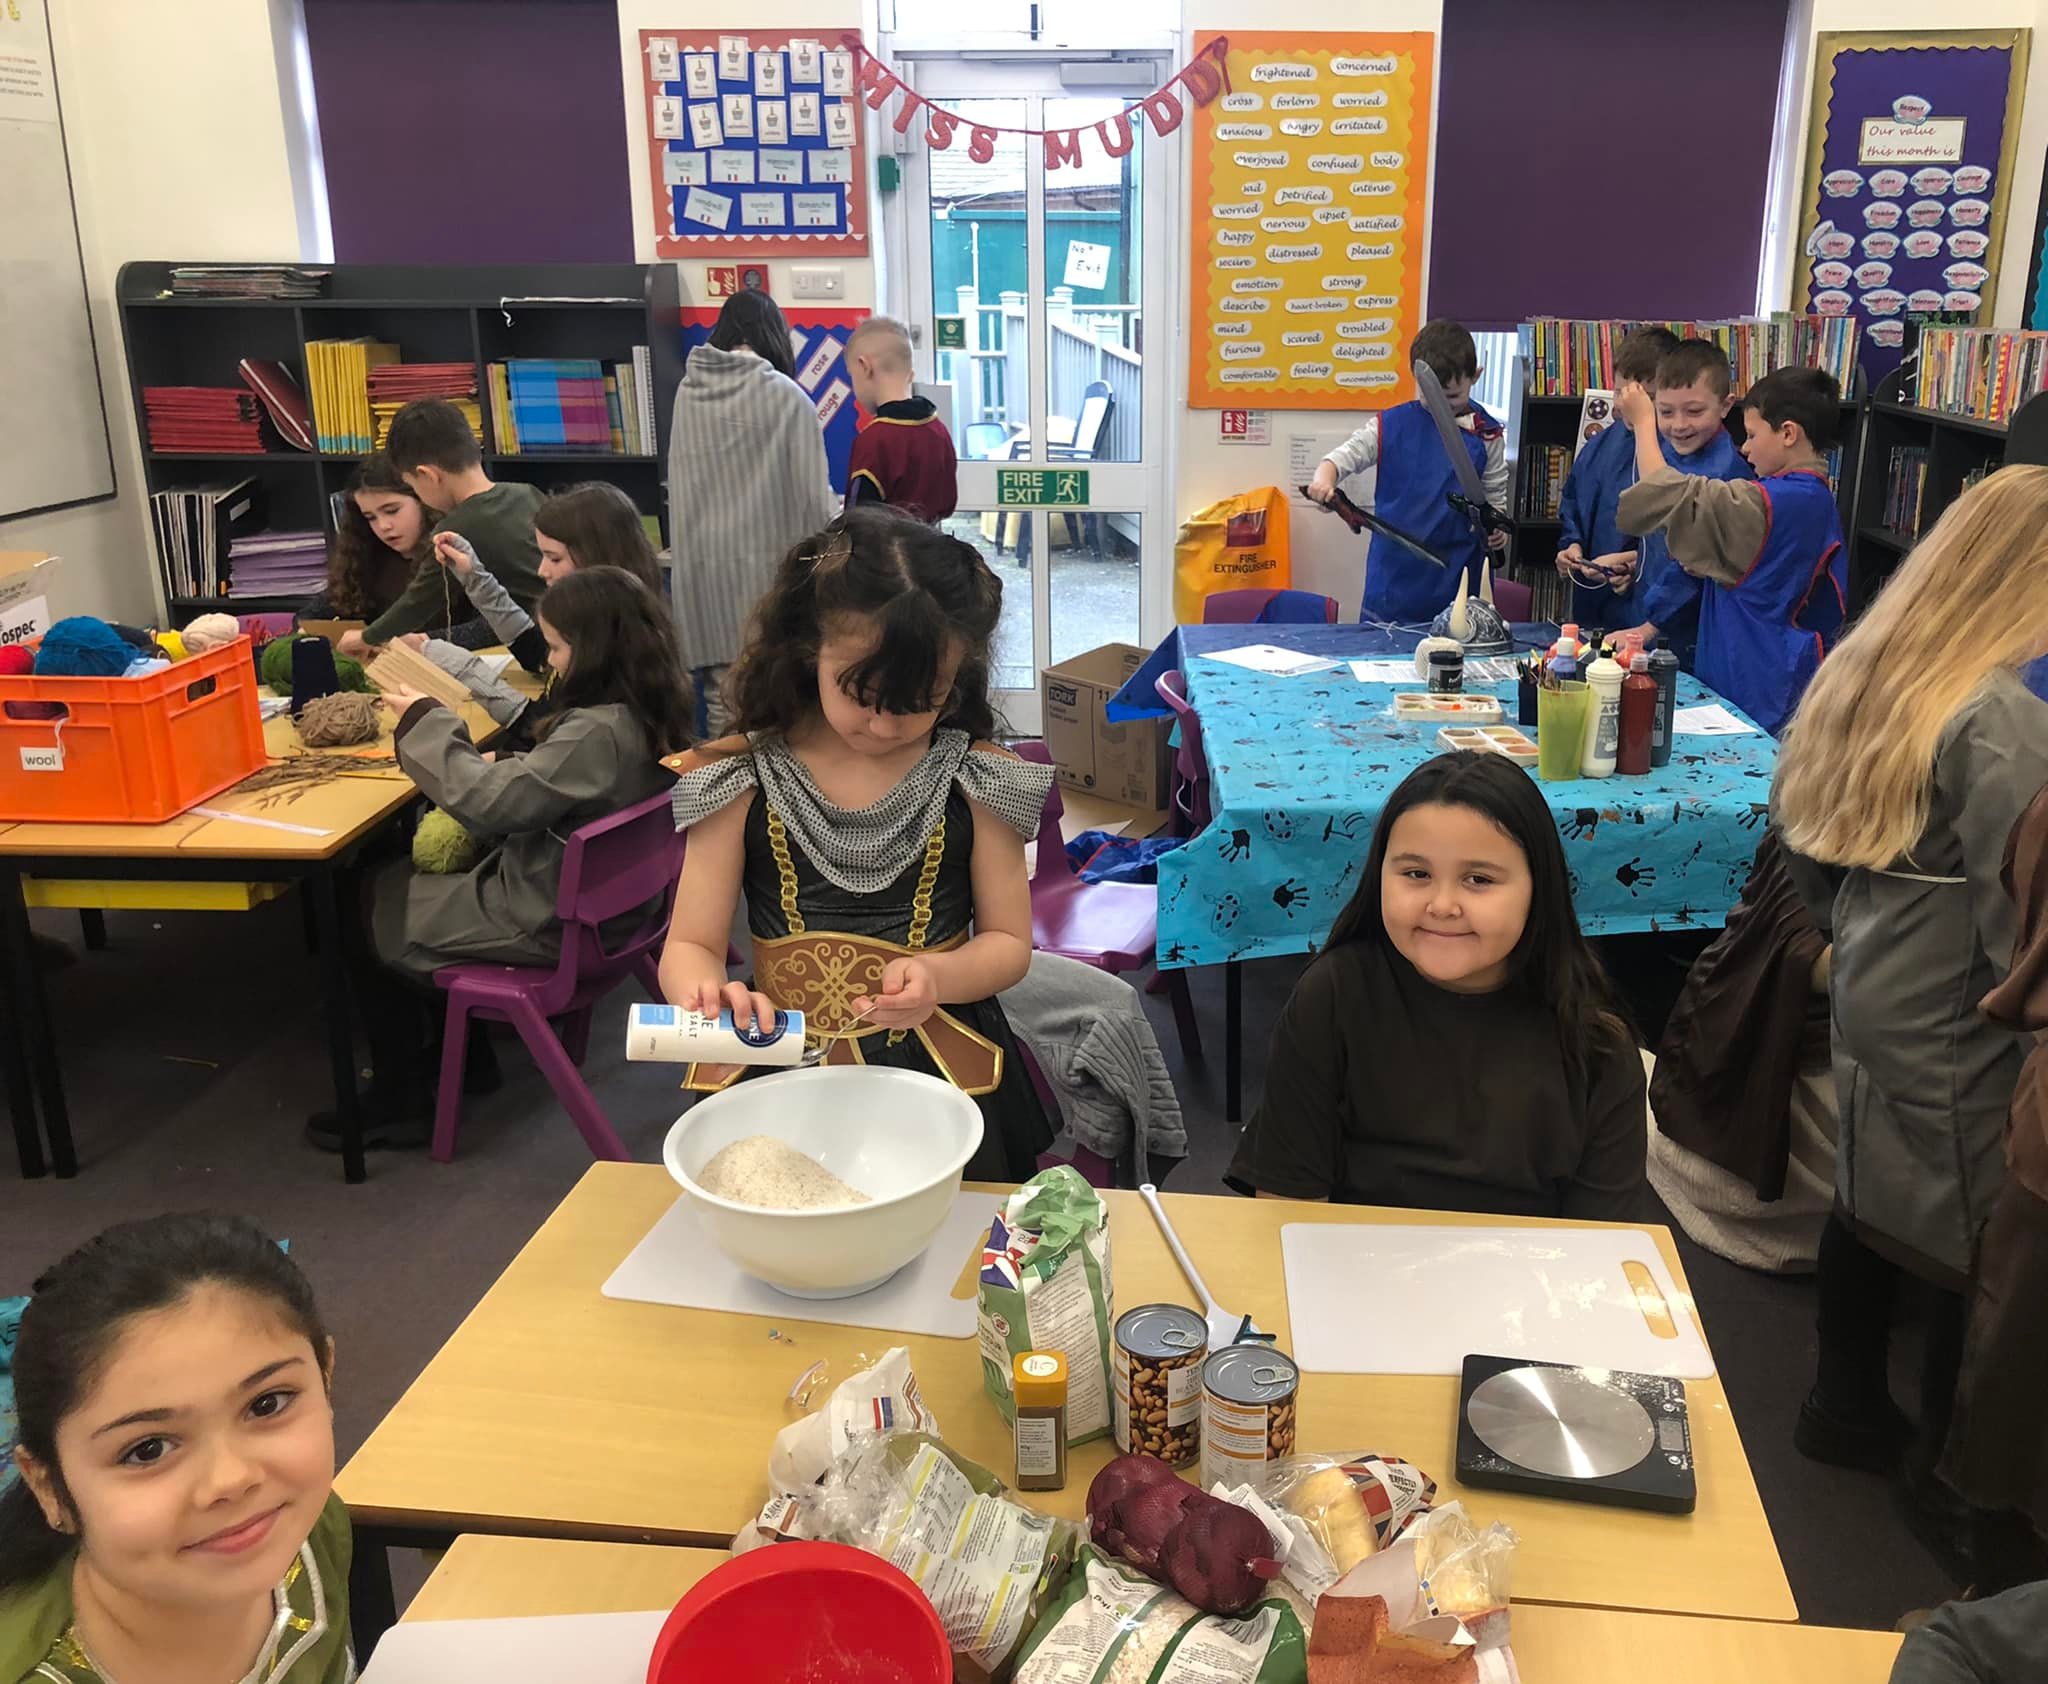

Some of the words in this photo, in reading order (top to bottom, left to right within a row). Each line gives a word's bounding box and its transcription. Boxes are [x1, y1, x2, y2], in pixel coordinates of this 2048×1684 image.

[1335, 61, 1392, 72] concerned
[1255, 66, 1312, 80] frightened
[1227, 97, 1254, 106] cross
[1276, 96, 1315, 107] forlorn
[1339, 96, 1381, 106] worried
[858, 57, 997, 164] MISS
[1221, 127, 1263, 136] anxious
[1335, 121, 1382, 131] irritated
[1869, 126, 1894, 136] Our
[1900, 125, 1936, 136] value
[1866, 145, 1893, 157] this
[1896, 145, 1941, 157] month
[1943, 145, 1956, 156] is
[1236, 155, 1286, 166] overjoyed
[1311, 159, 1359, 170] confused
[1373, 154, 1400, 166] body
[1243, 183, 1263, 193] sad
[1353, 184, 1391, 193] intense
[1281, 189, 1327, 201] petrified
[1218, 204, 1261, 215] worried
[1318, 210, 1346, 221] upset
[1265, 220, 1306, 229] nervous
[1354, 218, 1399, 230] satisfied
[1223, 230, 1254, 243] happy
[1268, 247, 1320, 259] distressed
[1351, 246, 1392, 257] pleased
[1218, 258, 1251, 267] secure
[1235, 279, 1280, 289] emotion
[1328, 277, 1362, 289] strong
[1223, 301, 1266, 311] describe
[1358, 297, 1394, 307] express
[1217, 323, 1247, 333] mind
[1342, 322, 1386, 334] troubled
[1287, 333, 1321, 344] scared
[1224, 344, 1261, 356] furious
[1335, 346, 1385, 358] delighted
[811, 354, 829, 374] rose
[1223, 369, 1278, 380] comfortable
[1293, 364, 1329, 376] feeling
[818, 392, 839, 420] rouge
[1003, 471, 1044, 487] FIRE
[1003, 488, 1043, 503] EXIT
[1239, 553, 1258, 564] FIRE
[1214, 560, 1277, 574] EXTINGUISHER
[25, 754, 57, 767] wool
[689, 1015, 697, 1039] SALT
